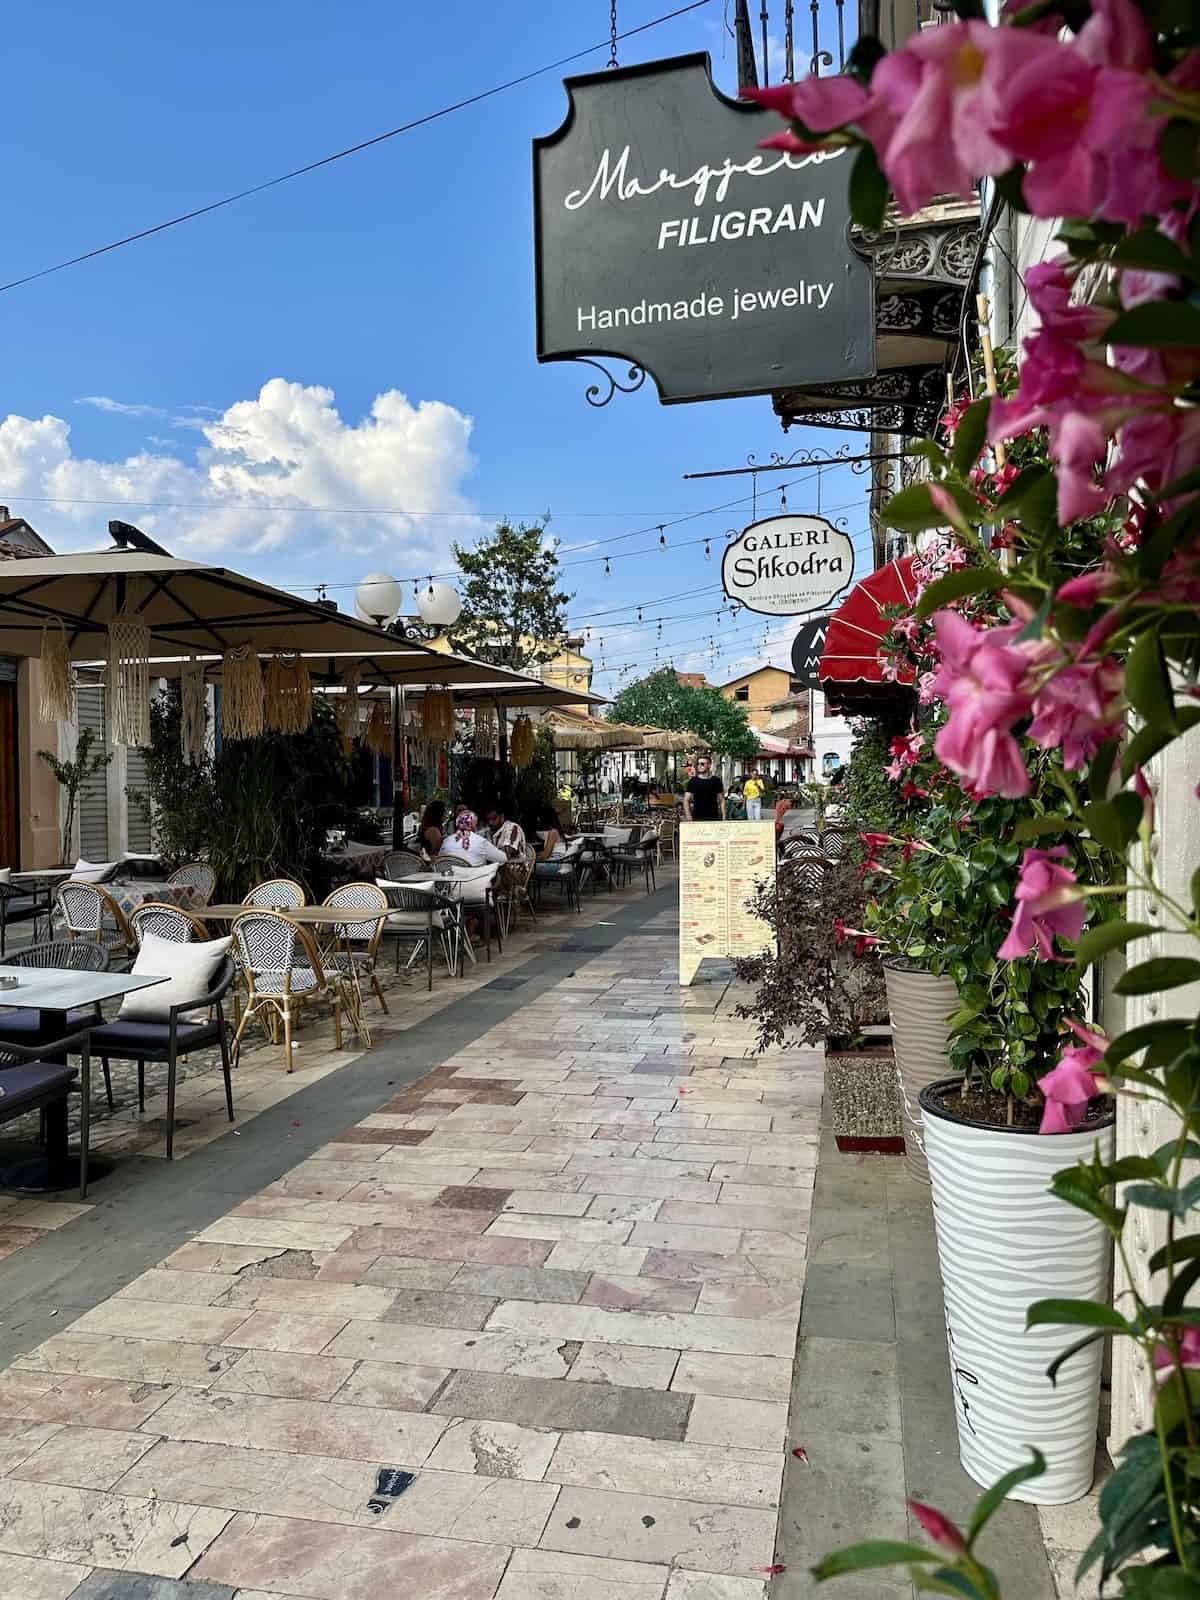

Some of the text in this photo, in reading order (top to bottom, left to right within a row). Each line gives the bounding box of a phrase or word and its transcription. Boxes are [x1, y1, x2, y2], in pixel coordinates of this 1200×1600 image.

[657, 198, 825, 250] FILIGRAN
[576, 280, 834, 331] Handmade jewelry
[743, 529, 830, 551] GALERI
[732, 551, 843, 588] Shkodra
